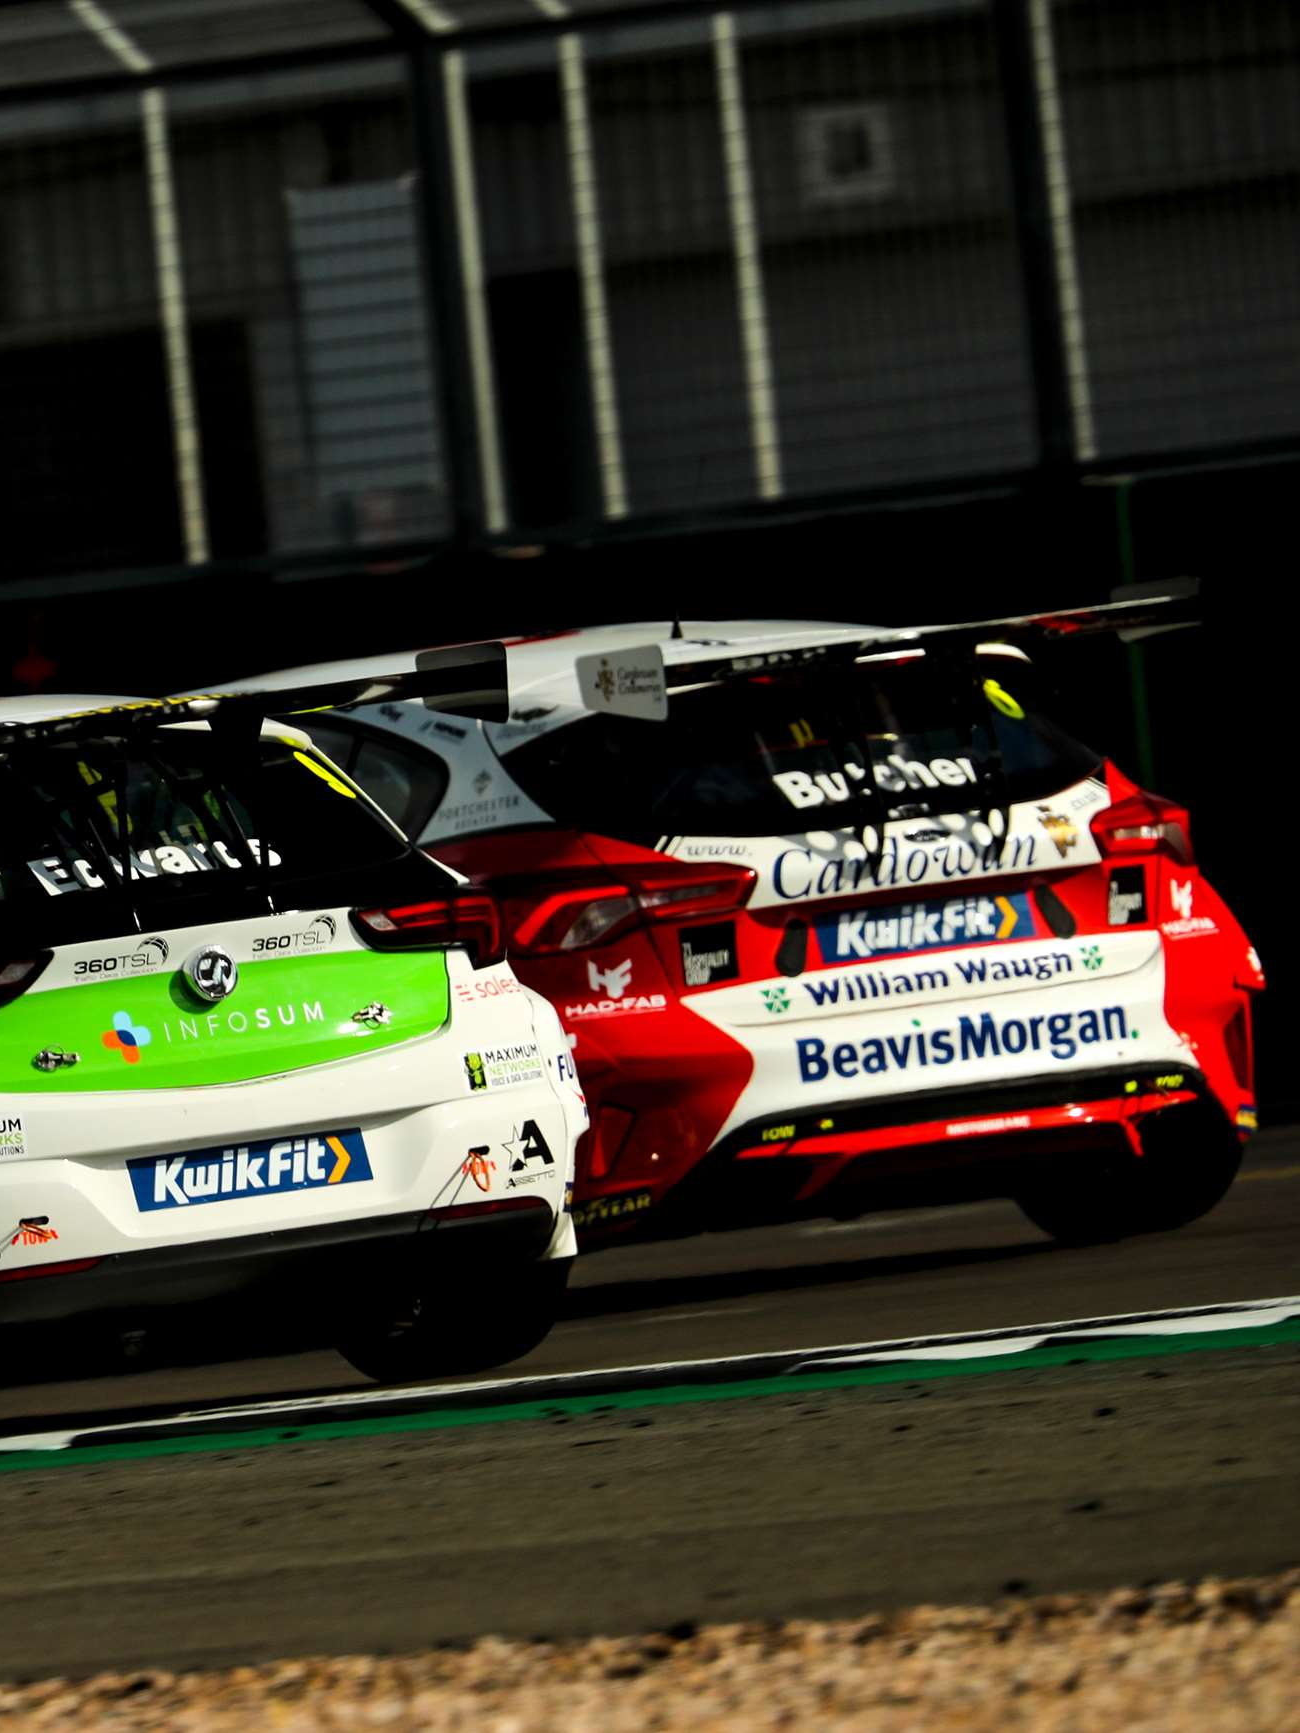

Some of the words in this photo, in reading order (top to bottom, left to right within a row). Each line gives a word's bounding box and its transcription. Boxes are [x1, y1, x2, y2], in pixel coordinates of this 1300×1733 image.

[252, 931, 326, 952] 360TSL
[74, 953, 158, 975] 360TSL
[804, 968, 950, 1007] William
[955, 952, 1073, 984] Waugh
[164, 1001, 326, 1044] INFOSUM
[485, 1043, 540, 1065] MAXIMUM
